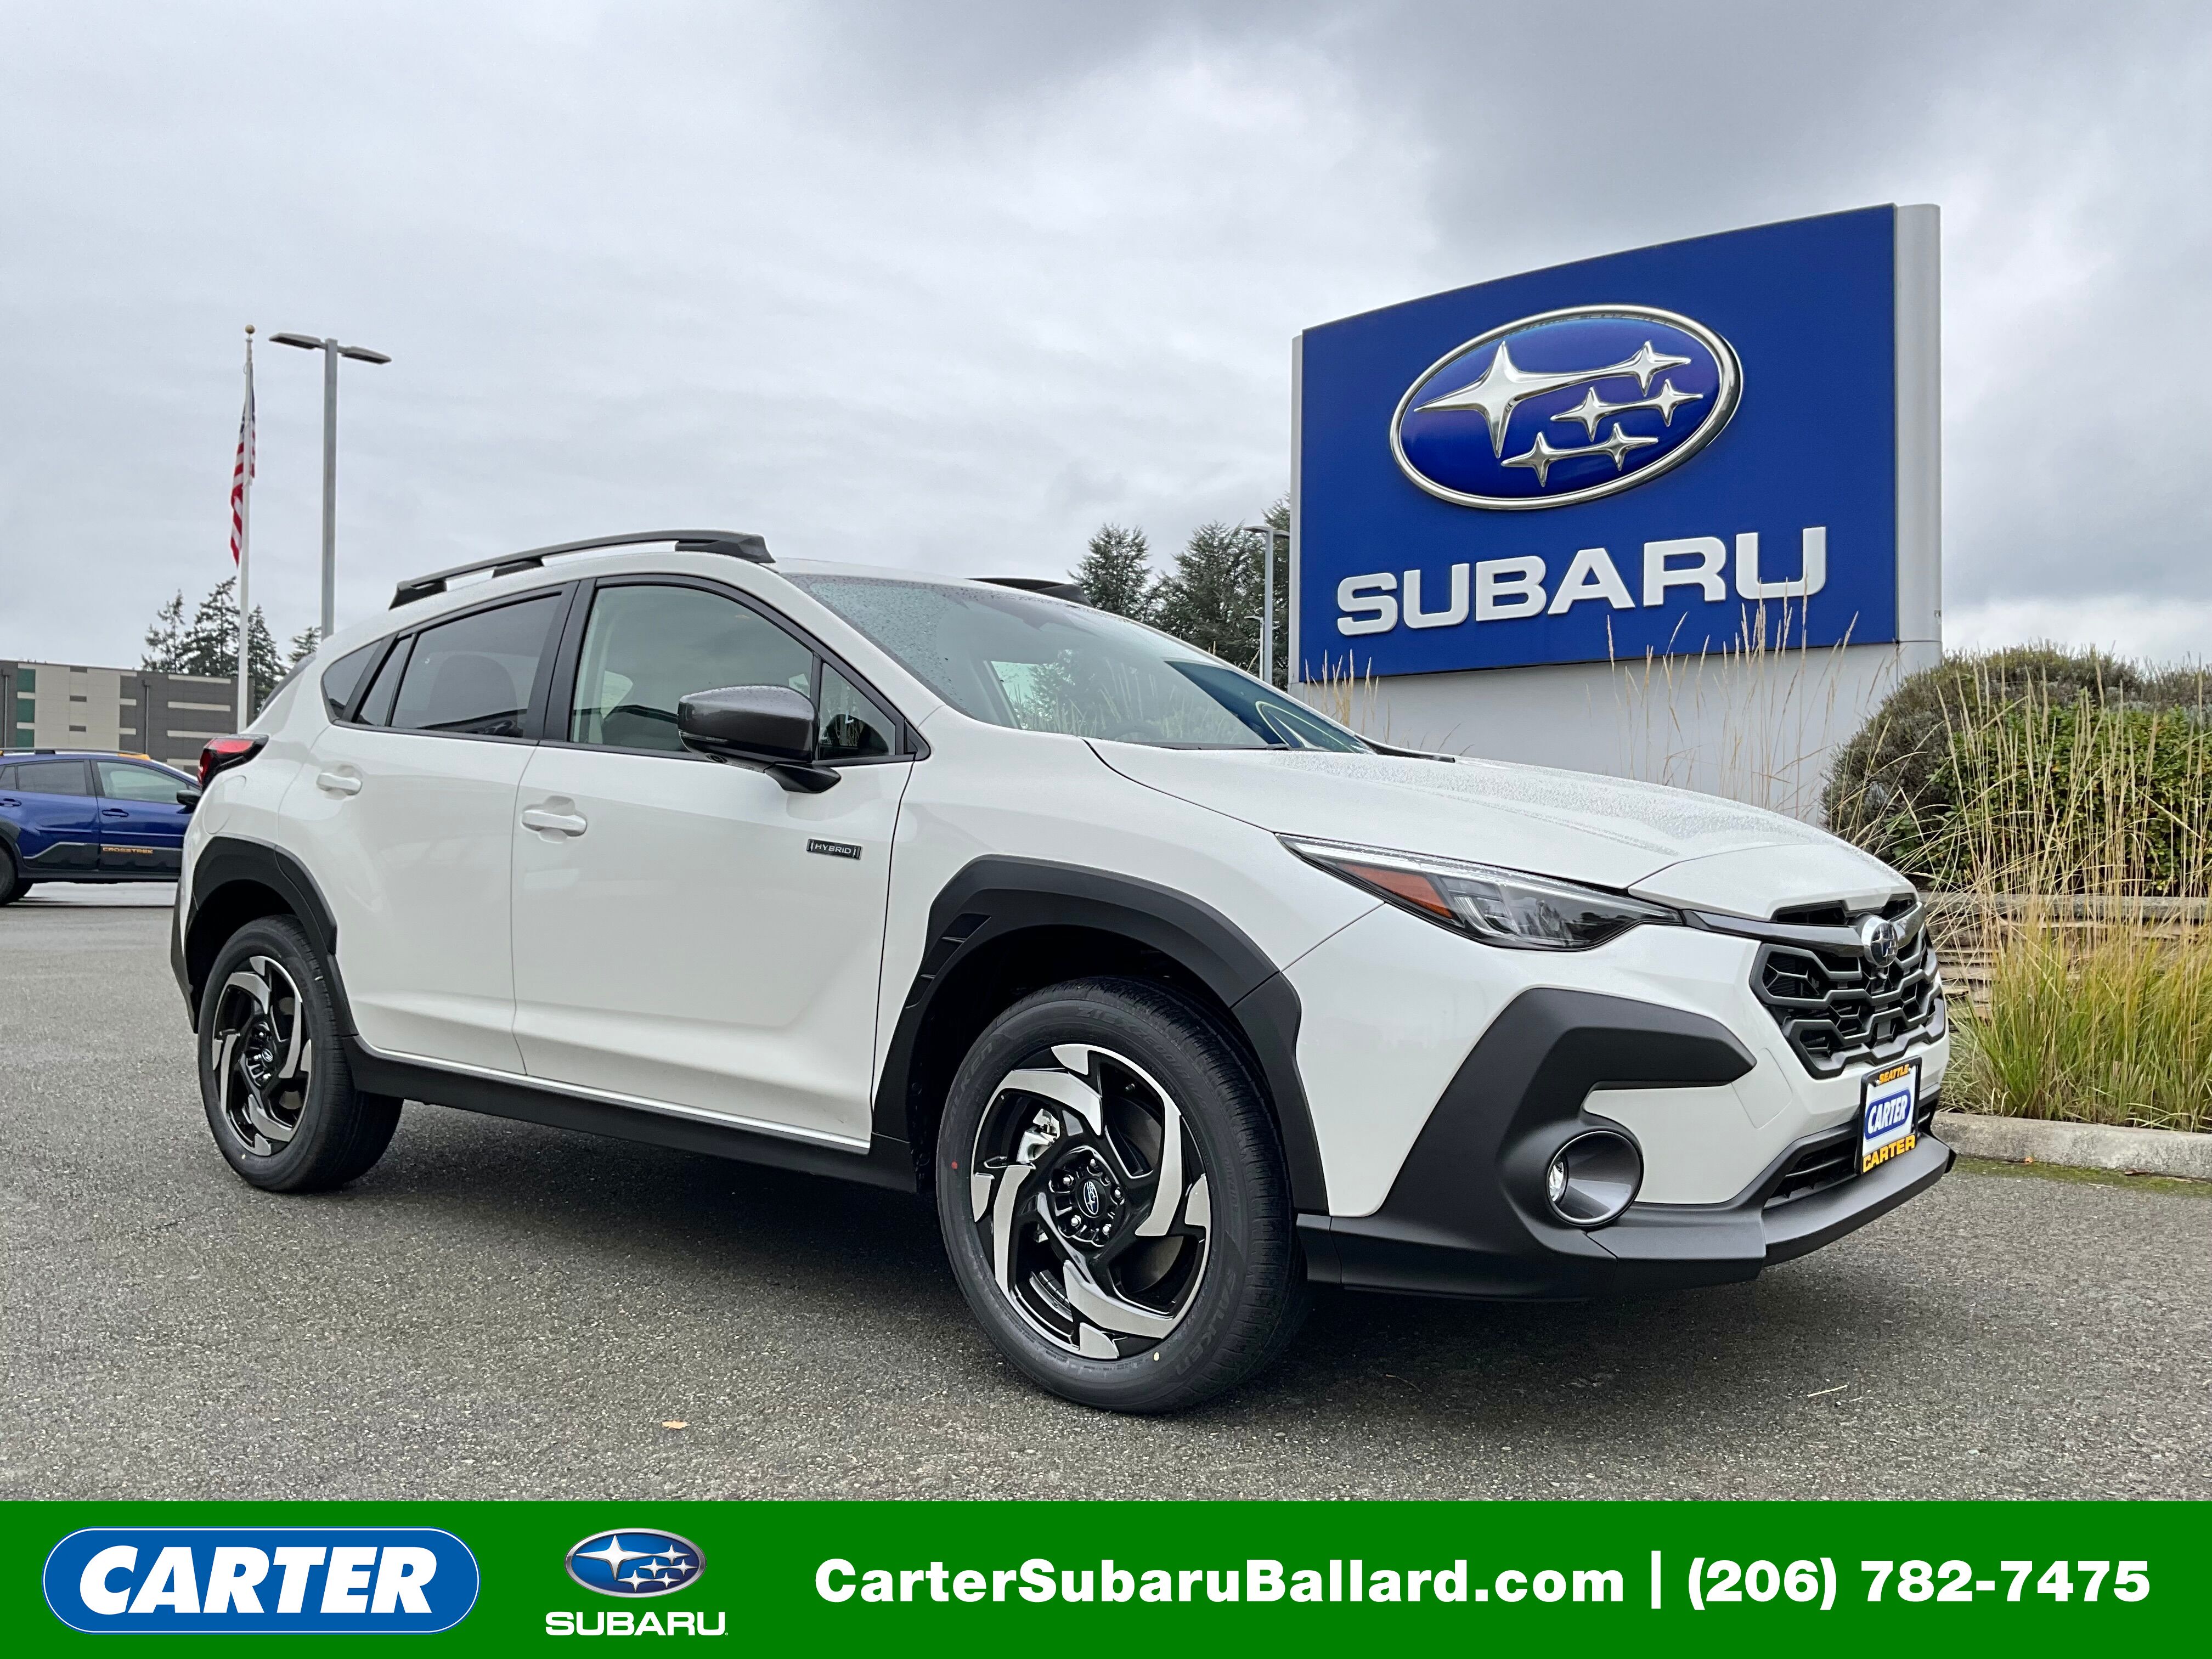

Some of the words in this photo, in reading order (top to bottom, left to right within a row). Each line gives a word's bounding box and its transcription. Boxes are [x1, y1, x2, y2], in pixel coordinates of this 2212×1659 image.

[1337, 526, 1826, 636] SUBARU
[815, 843, 851, 854] HYBRID
[1879, 1064, 1910, 1085] SEATTLE
[1867, 1094, 1908, 1134] CARTER
[1863, 1135, 1915, 1173] CARTER
